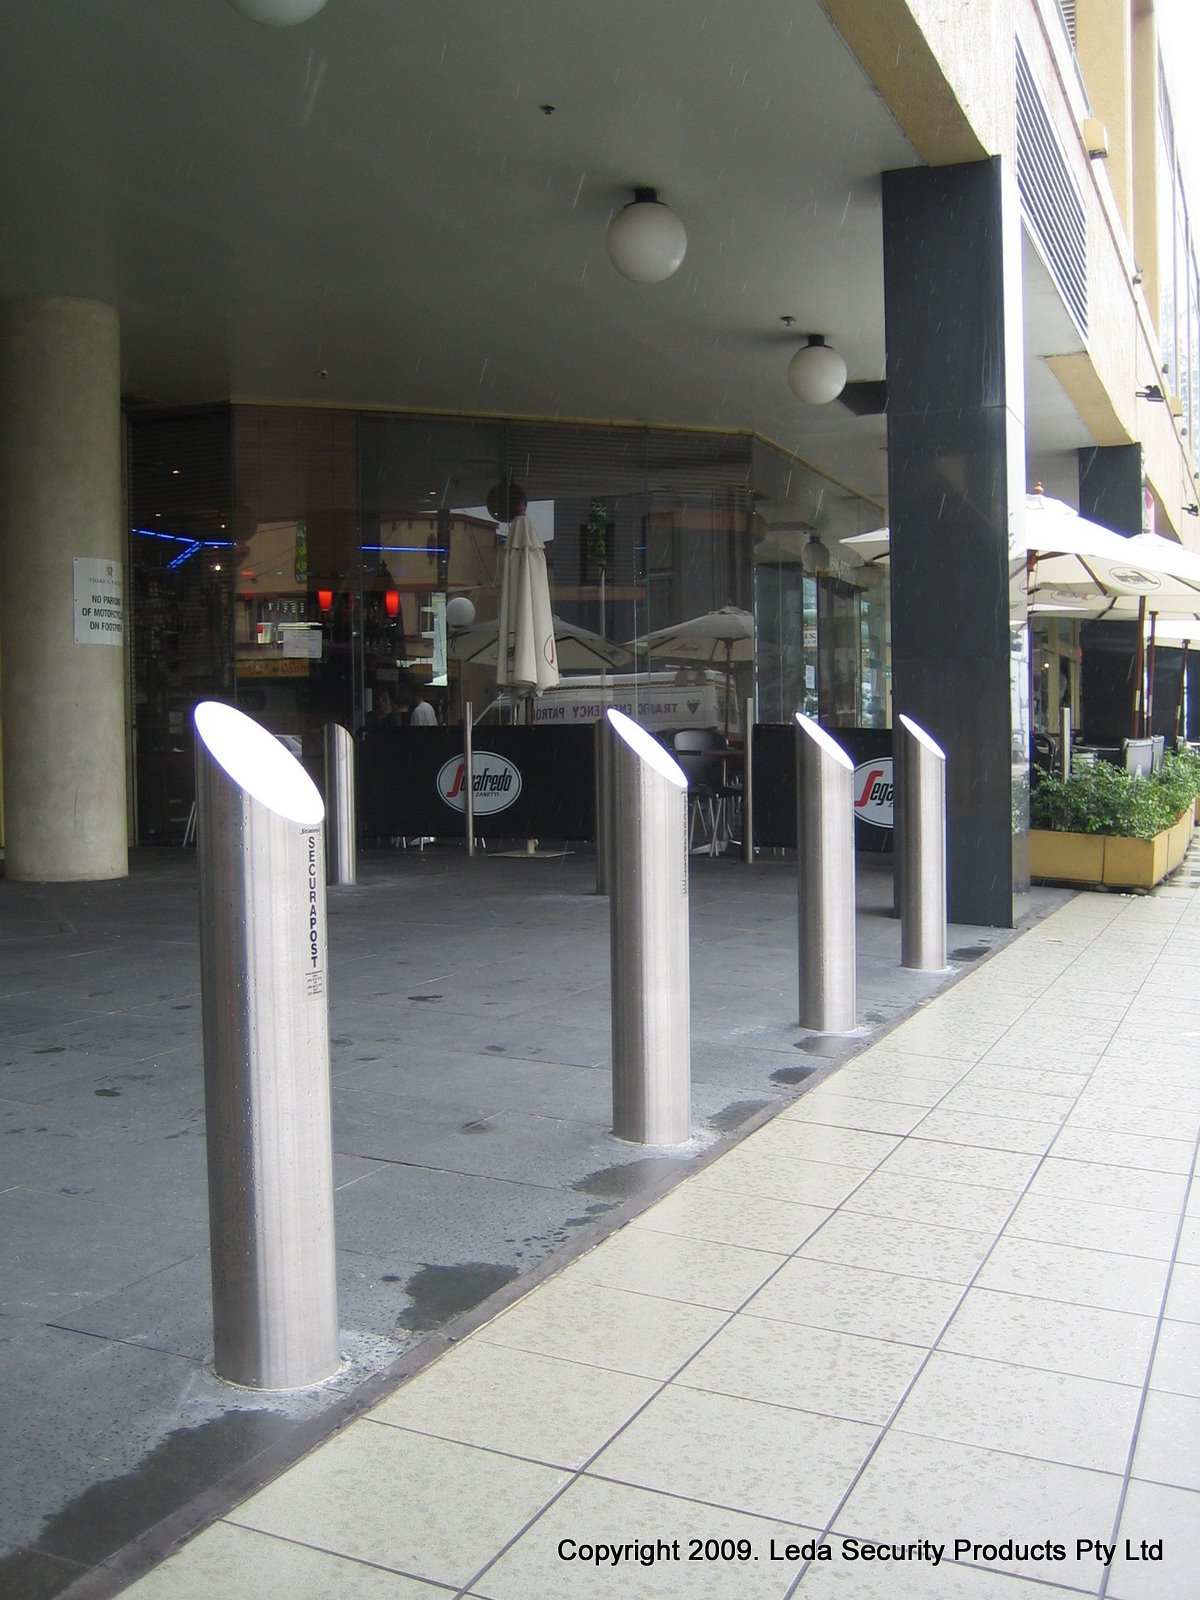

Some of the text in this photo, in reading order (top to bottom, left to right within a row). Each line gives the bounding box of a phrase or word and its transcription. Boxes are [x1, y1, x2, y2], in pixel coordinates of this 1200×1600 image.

[92, 595, 102, 604] NO
[82, 607, 92, 617] OF
[90, 621, 100, 631] ON
[308, 836, 318, 968] SECURAPOST
